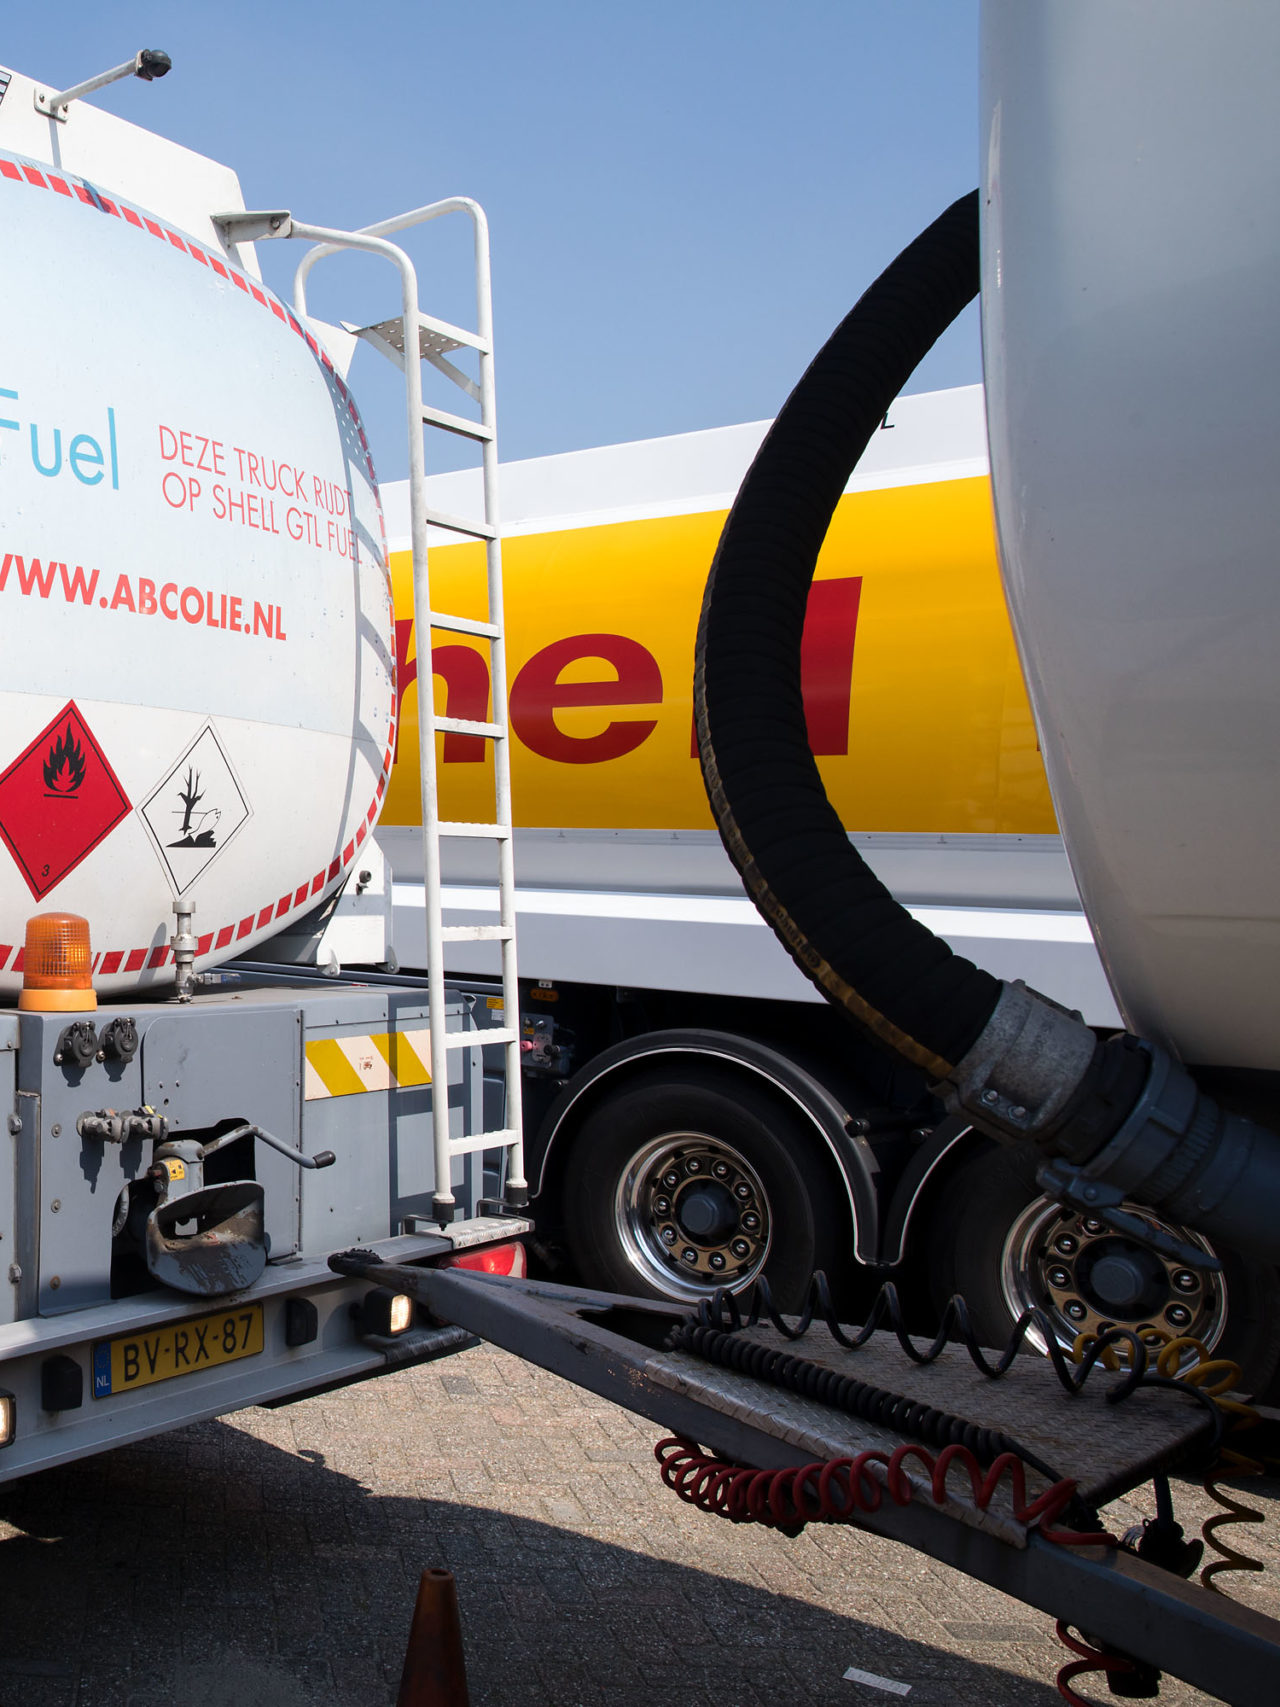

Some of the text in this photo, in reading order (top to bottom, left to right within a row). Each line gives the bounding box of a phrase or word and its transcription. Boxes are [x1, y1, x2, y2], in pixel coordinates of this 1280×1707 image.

[158, 424, 351, 525] DEZE TRUCK RIJDT
[162, 471, 363, 565] OP SHELL GTL FUEL
[40, 863, 51, 878] 3
[96, 1312, 254, 1389] NL BV-RX-87
